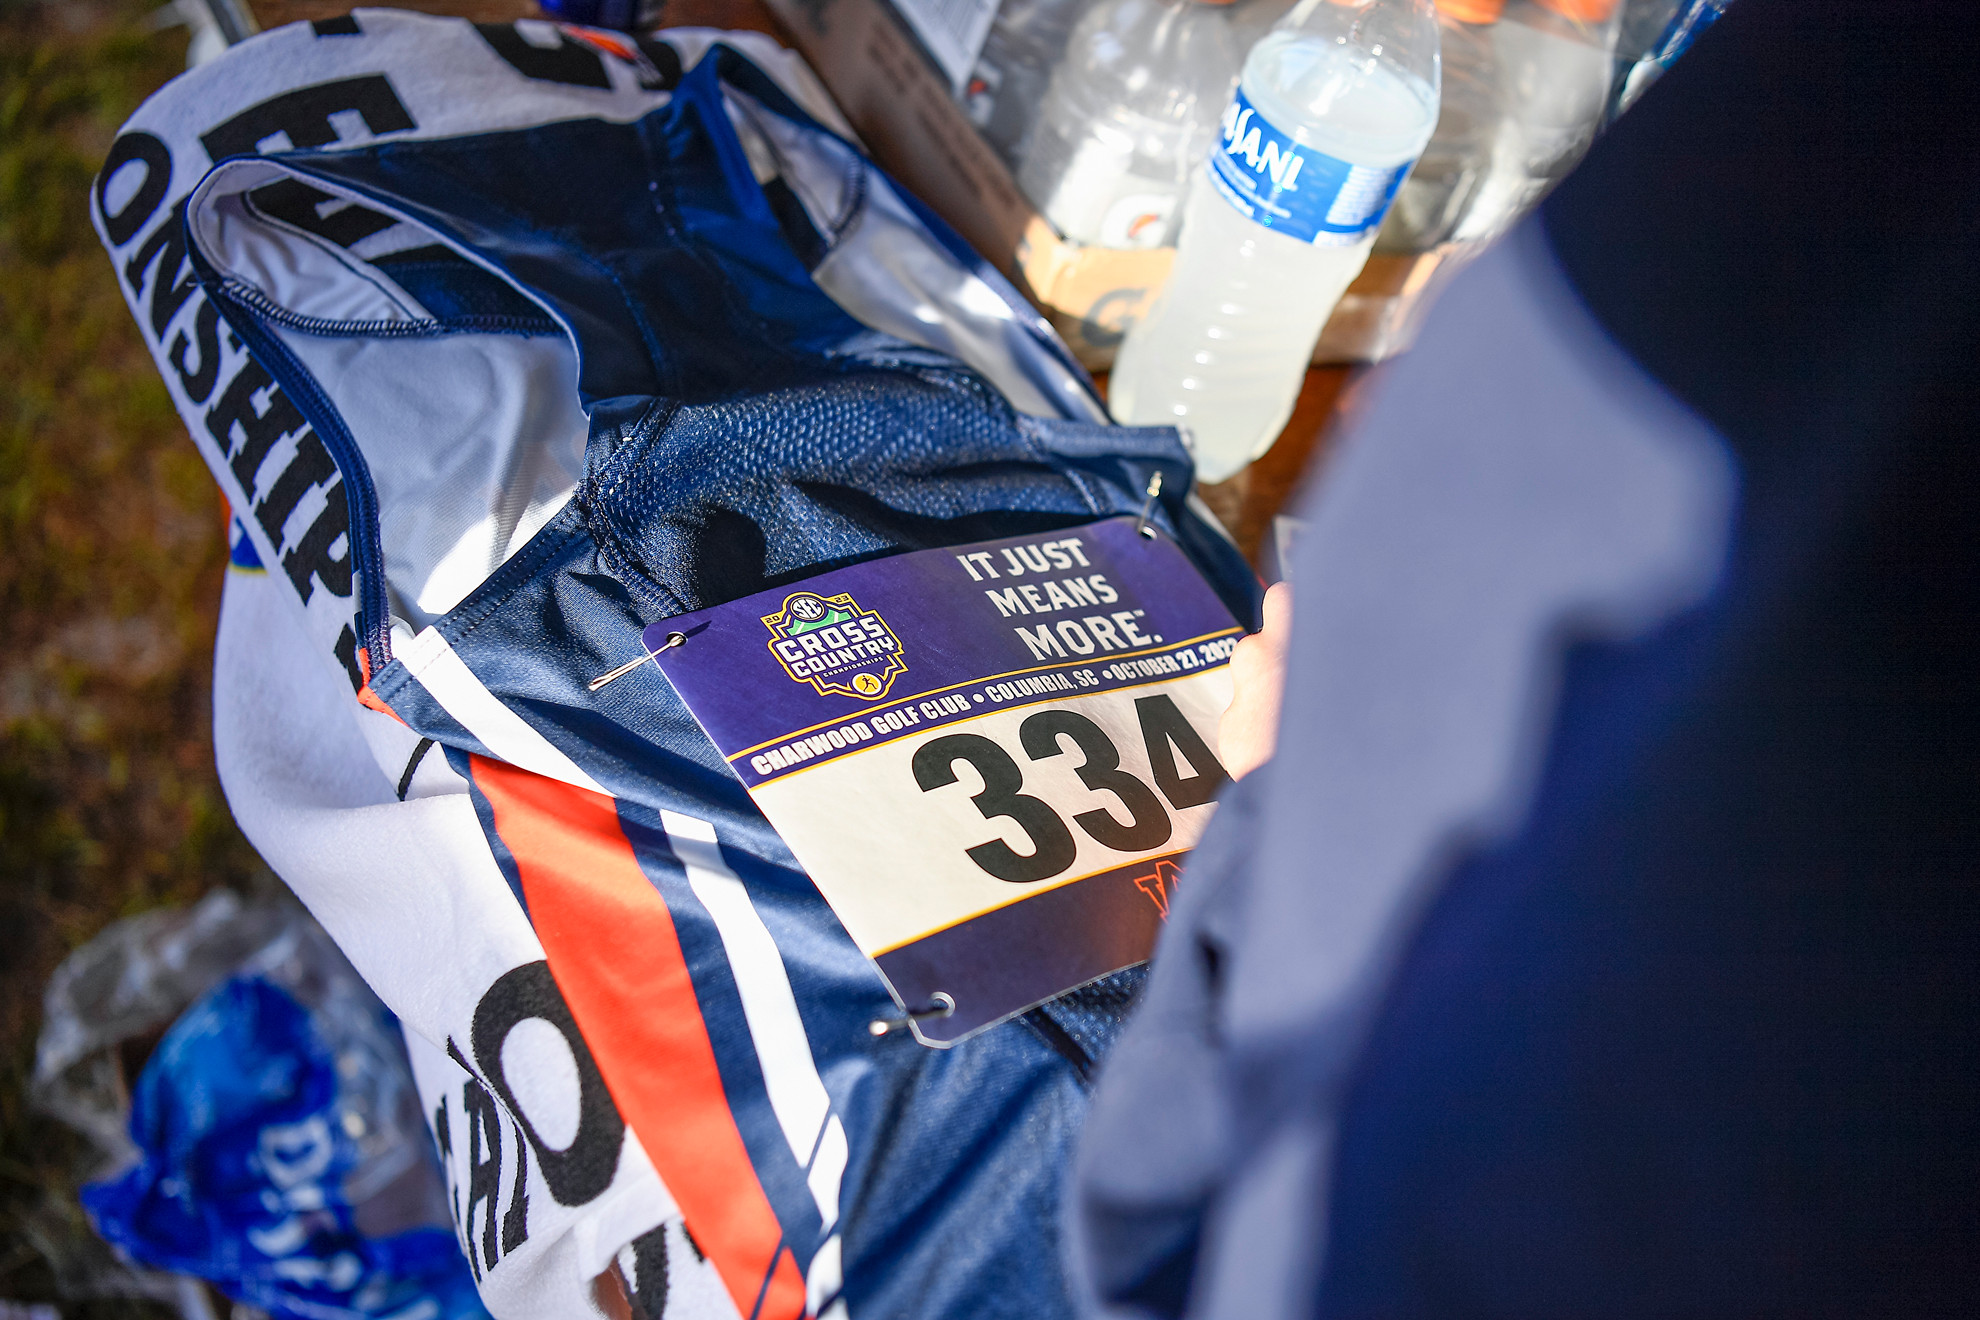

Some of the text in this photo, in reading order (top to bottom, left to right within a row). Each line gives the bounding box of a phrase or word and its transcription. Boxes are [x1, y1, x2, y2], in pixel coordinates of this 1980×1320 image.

[956, 537, 1091, 582] IT JUST
[792, 597, 823, 619] SEC
[834, 595, 850, 603] 23
[985, 574, 1119, 618] MEANS
[765, 614, 781, 624] 20
[775, 616, 886, 663] CROSS
[790, 636, 896, 678] COUNTRY
[823, 656, 885, 678] CHAMPIONSHIPS
[750, 721, 874, 776] CHARWOOD
[870, 705, 921, 735] GOLF
[919, 693, 972, 720] CLUB
[984, 672, 1079, 703] COLUMBIA,
[1072, 668, 1100, 687] SC
[1109, 655, 1182, 681] OCTOBER
[1175, 648, 1206, 669] 27,
[911, 694, 1230, 883] 334
